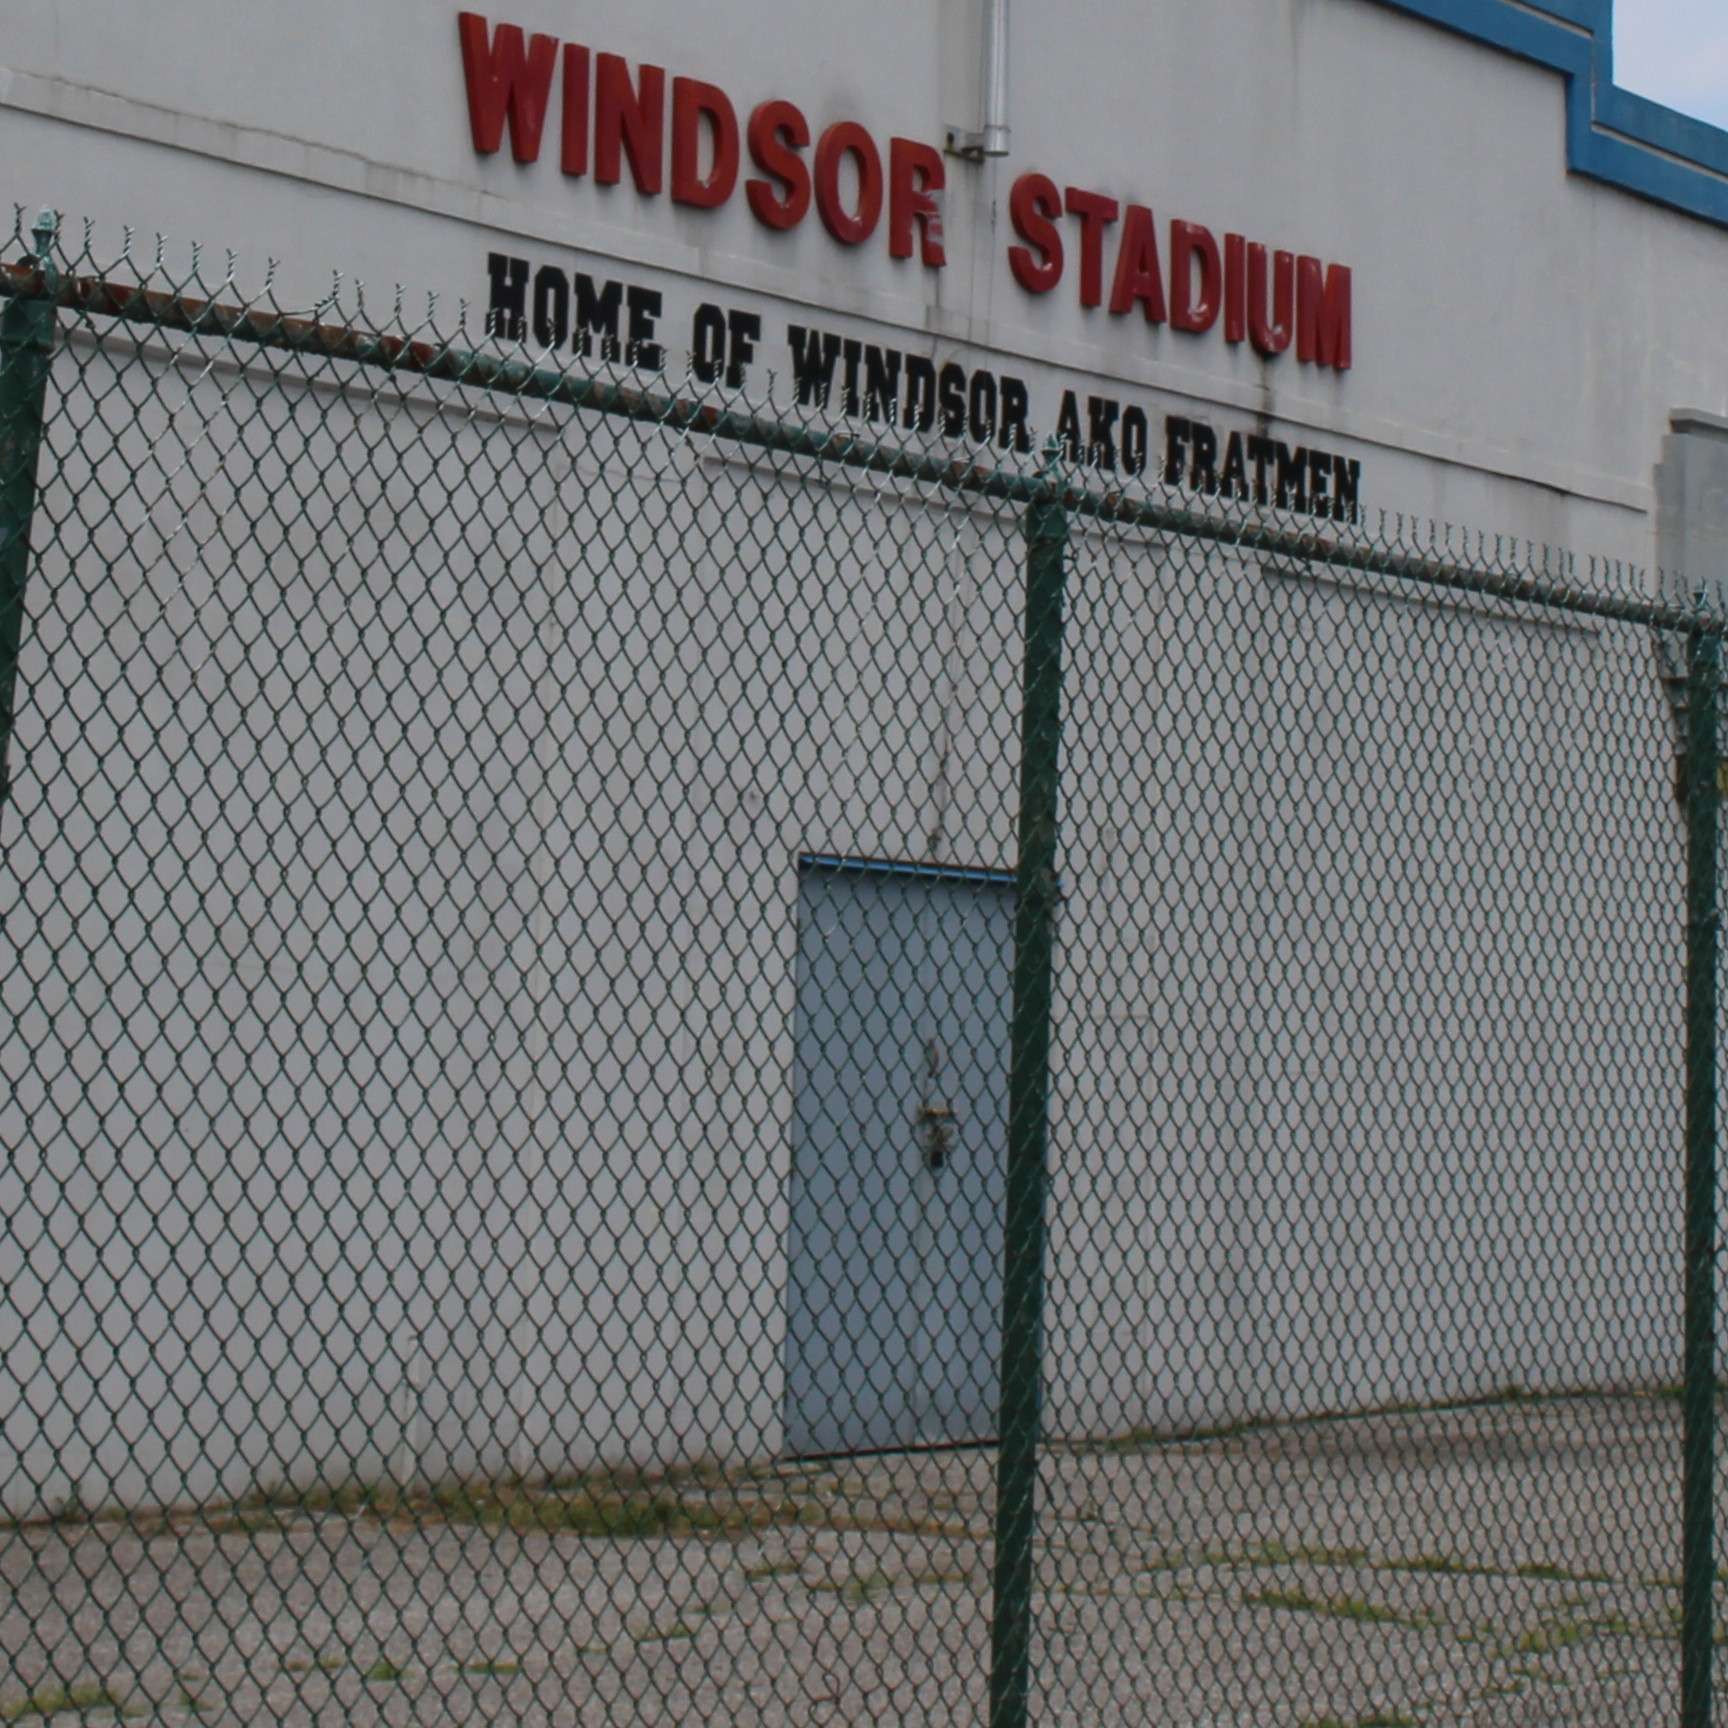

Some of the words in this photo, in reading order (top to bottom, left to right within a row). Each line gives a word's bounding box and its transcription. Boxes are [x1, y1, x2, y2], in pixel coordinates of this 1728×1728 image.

[458, 11, 947, 267] WINDSOR
[1008, 173, 1352, 370] STADIUM
[485, 252, 663, 371] HOME
[692, 303, 761, 389] OF
[787, 325, 1029, 453] WINDSOR
[1054, 390, 1148, 475] AKO
[1164, 415, 1361, 524] FRATMEN
